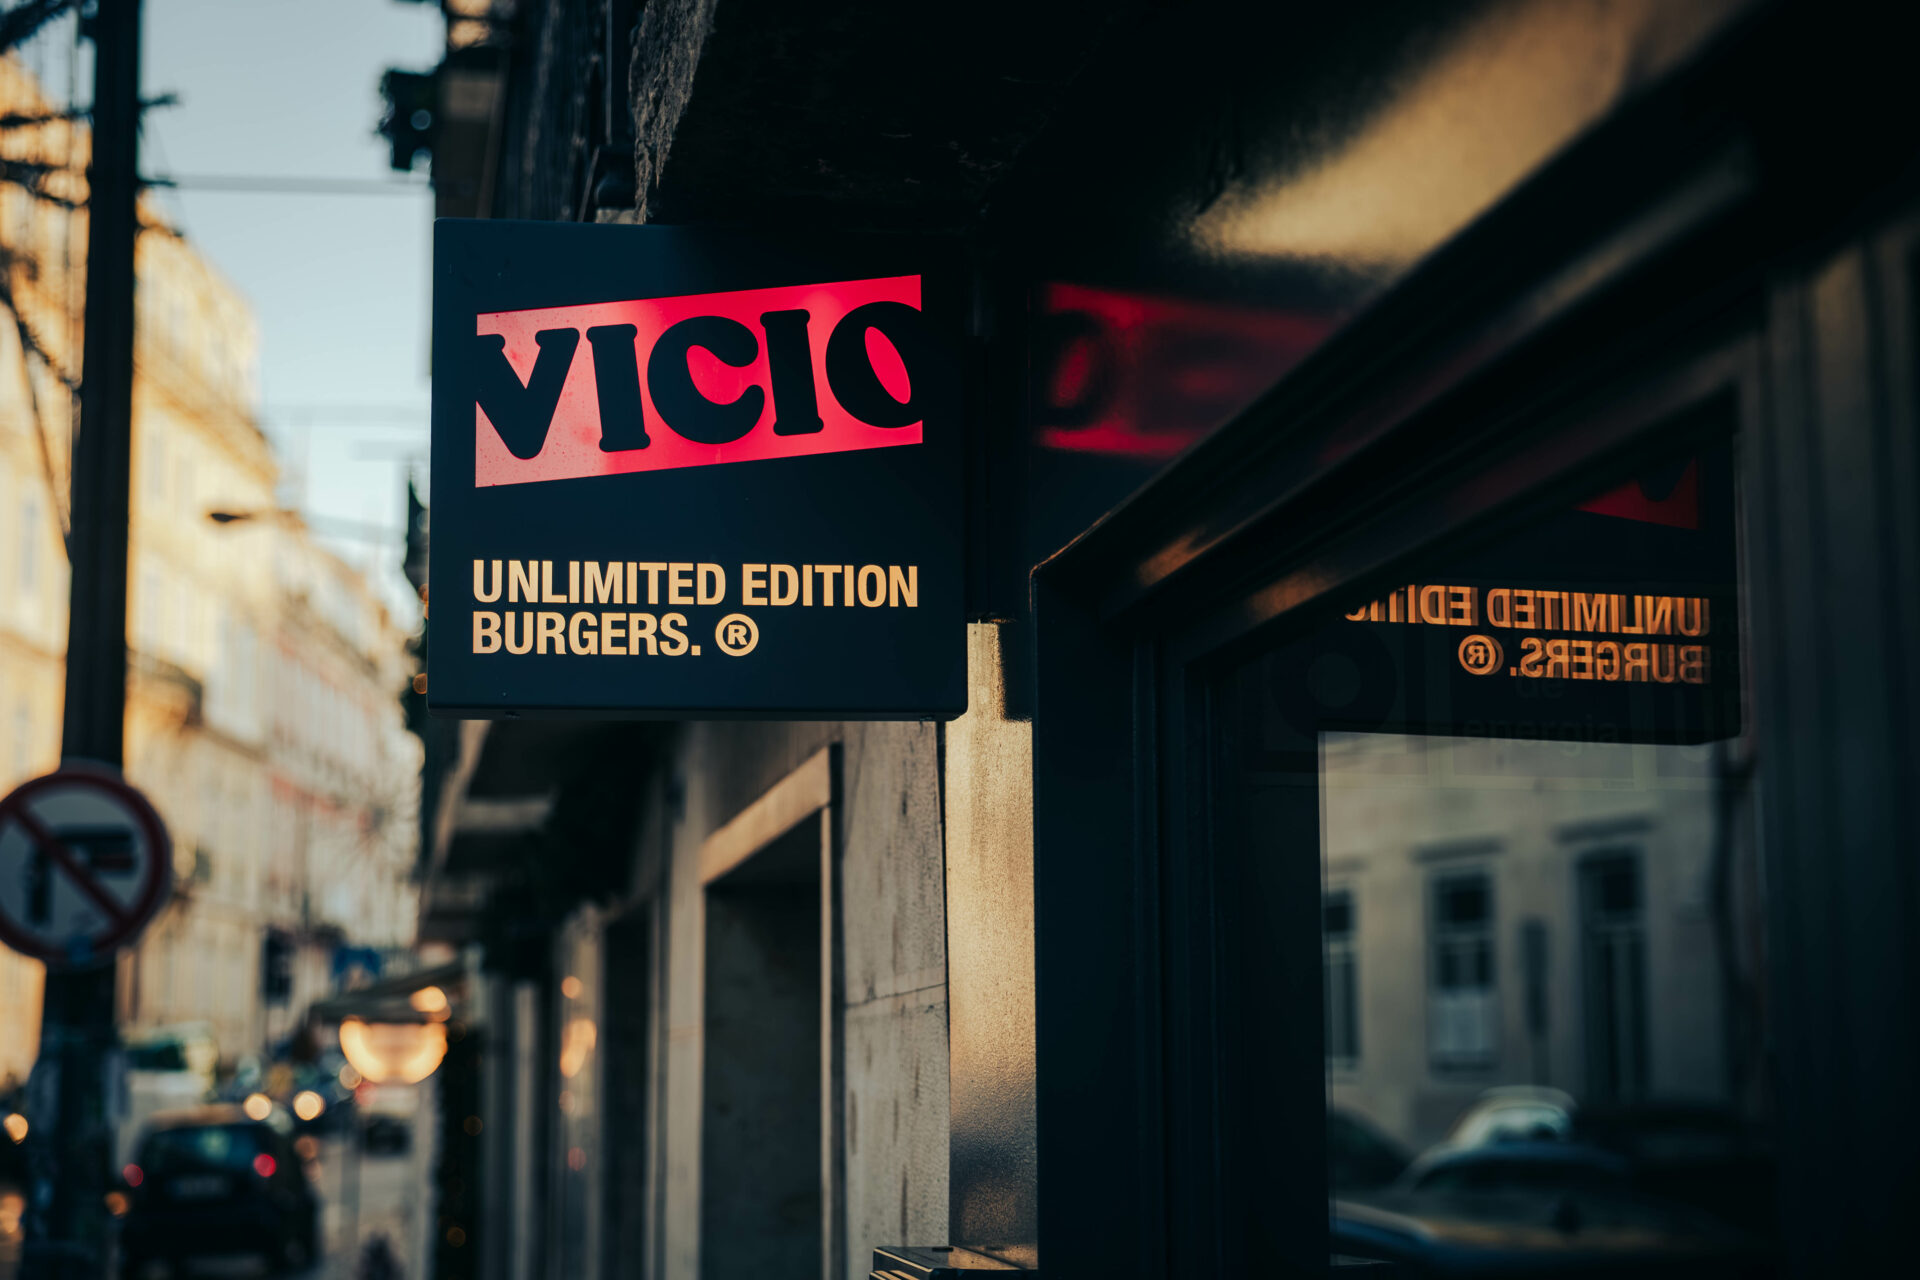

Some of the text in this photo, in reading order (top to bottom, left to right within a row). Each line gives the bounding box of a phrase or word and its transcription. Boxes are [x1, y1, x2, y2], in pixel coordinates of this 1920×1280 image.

[476, 301, 922, 460] VICIO
[472, 559, 919, 608] UNLIMITED EDITION
[472, 611, 701, 656] BURGERS.
